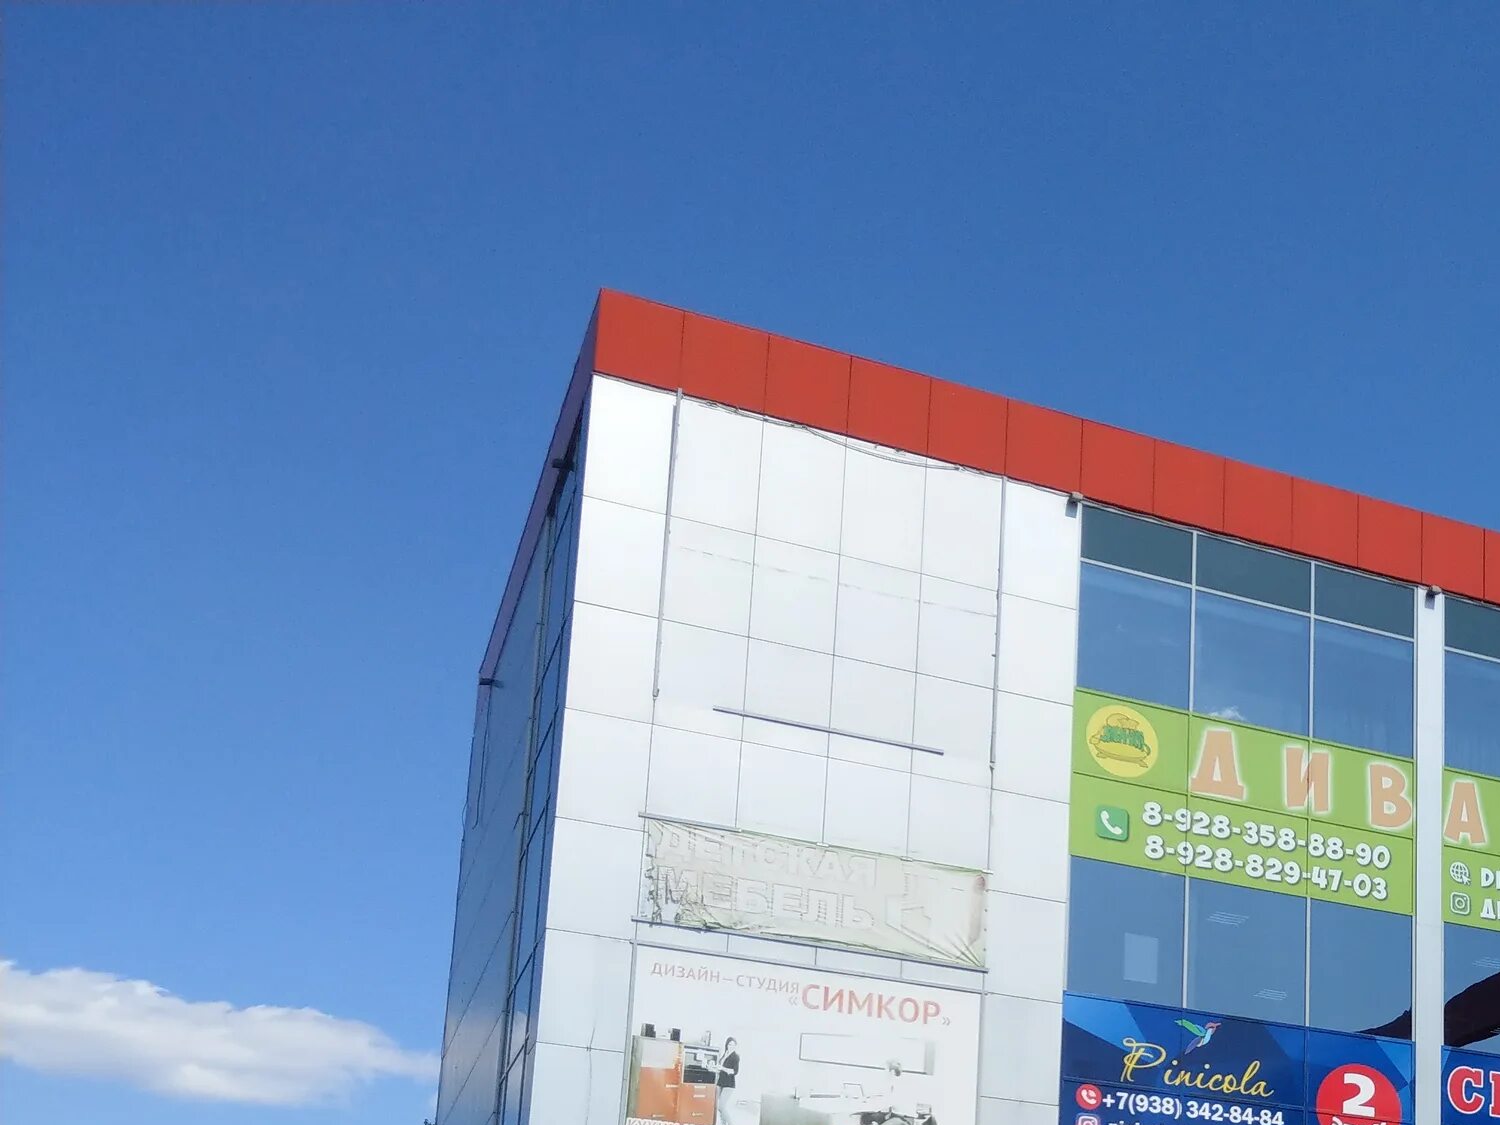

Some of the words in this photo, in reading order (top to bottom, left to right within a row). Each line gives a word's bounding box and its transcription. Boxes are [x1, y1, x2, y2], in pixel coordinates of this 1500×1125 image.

[1141, 801, 1391, 870] 8-928-358-88-90
[1143, 834, 1388, 901] 8-928-829-47-03
[1123, 1037, 1274, 1098] Pinicola
[1341, 1073, 1376, 1118] 2
[1101, 1091, 1183, 1119] +7(938)
